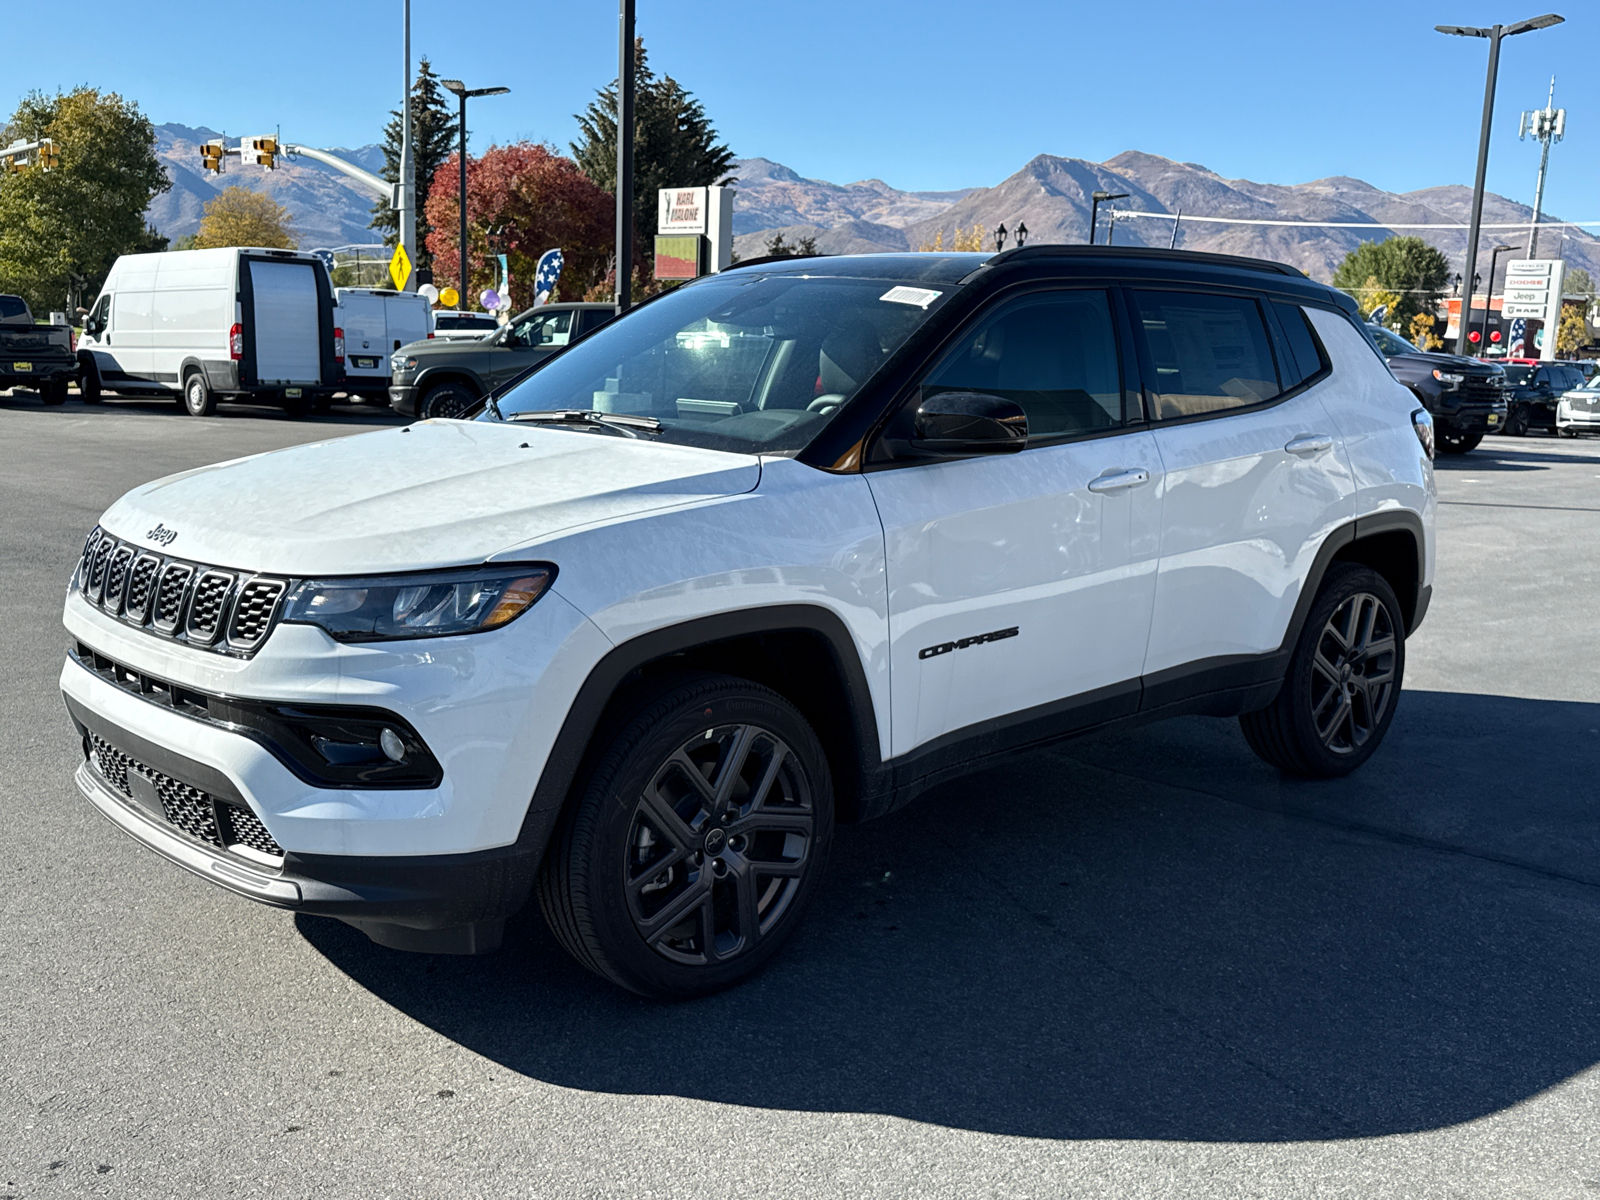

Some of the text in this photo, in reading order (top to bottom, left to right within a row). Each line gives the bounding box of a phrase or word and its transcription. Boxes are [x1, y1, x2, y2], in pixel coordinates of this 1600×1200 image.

[676, 191, 695, 206] KARL
[670, 207, 699, 222] MALONE
[1513, 292, 1536, 301] Jeep
[146, 523, 178, 547] Jeep
[918, 626, 1019, 660] COMPASS
